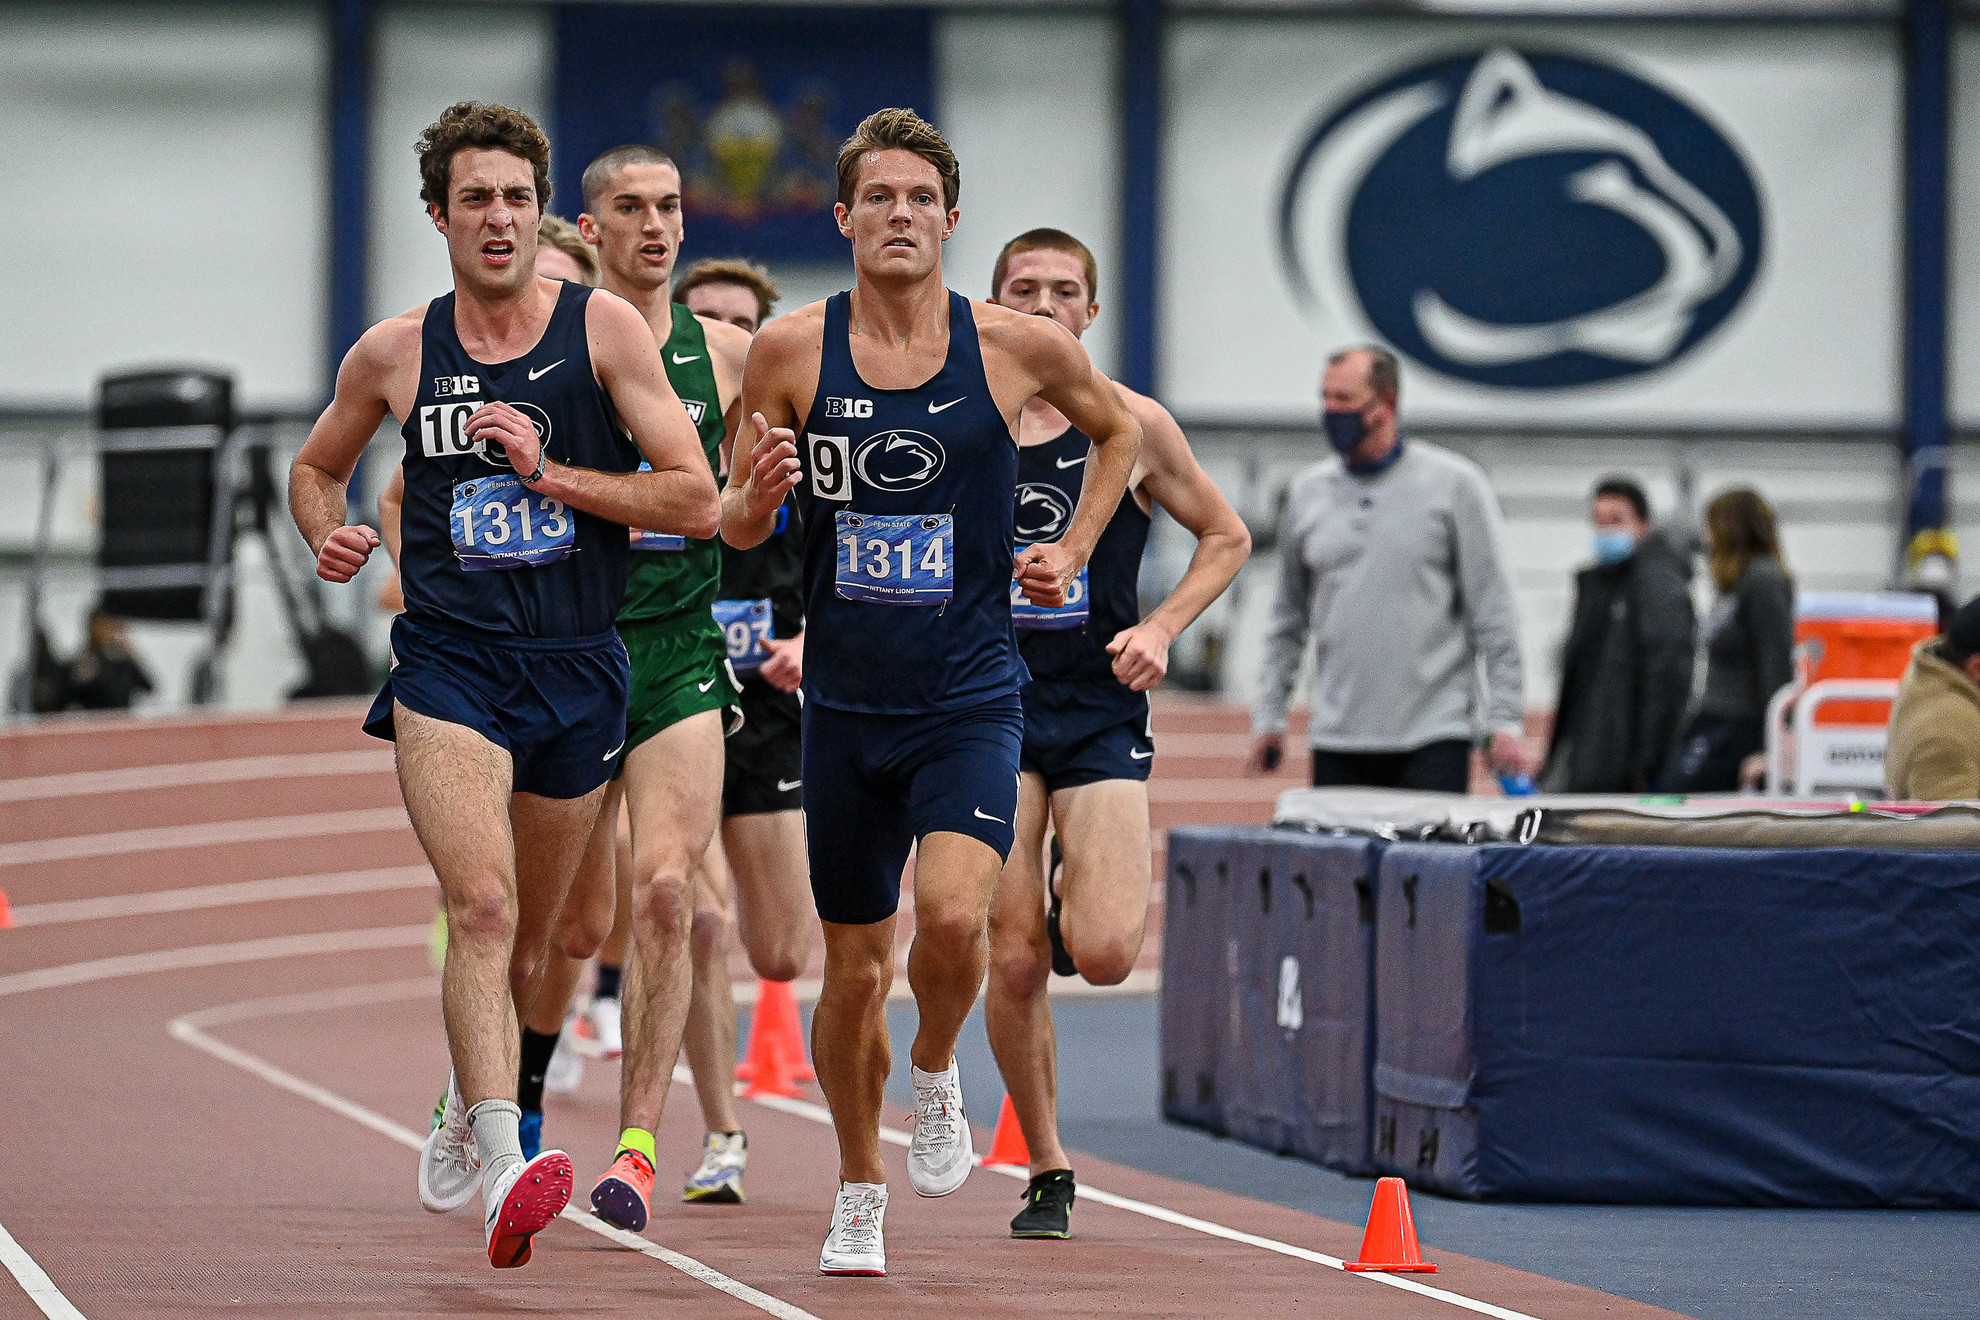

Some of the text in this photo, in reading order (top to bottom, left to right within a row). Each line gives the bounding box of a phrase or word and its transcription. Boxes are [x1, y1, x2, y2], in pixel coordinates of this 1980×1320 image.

[425, 404, 475, 453] 10
[813, 439, 844, 496] 9
[487, 481, 506, 489] PENN
[455, 498, 568, 546] 1313
[873, 520, 891, 528] PENN
[490, 548, 539, 560] NITTANY LIONS
[842, 534, 947, 579] 1314
[869, 585, 895, 594] NITTANY
